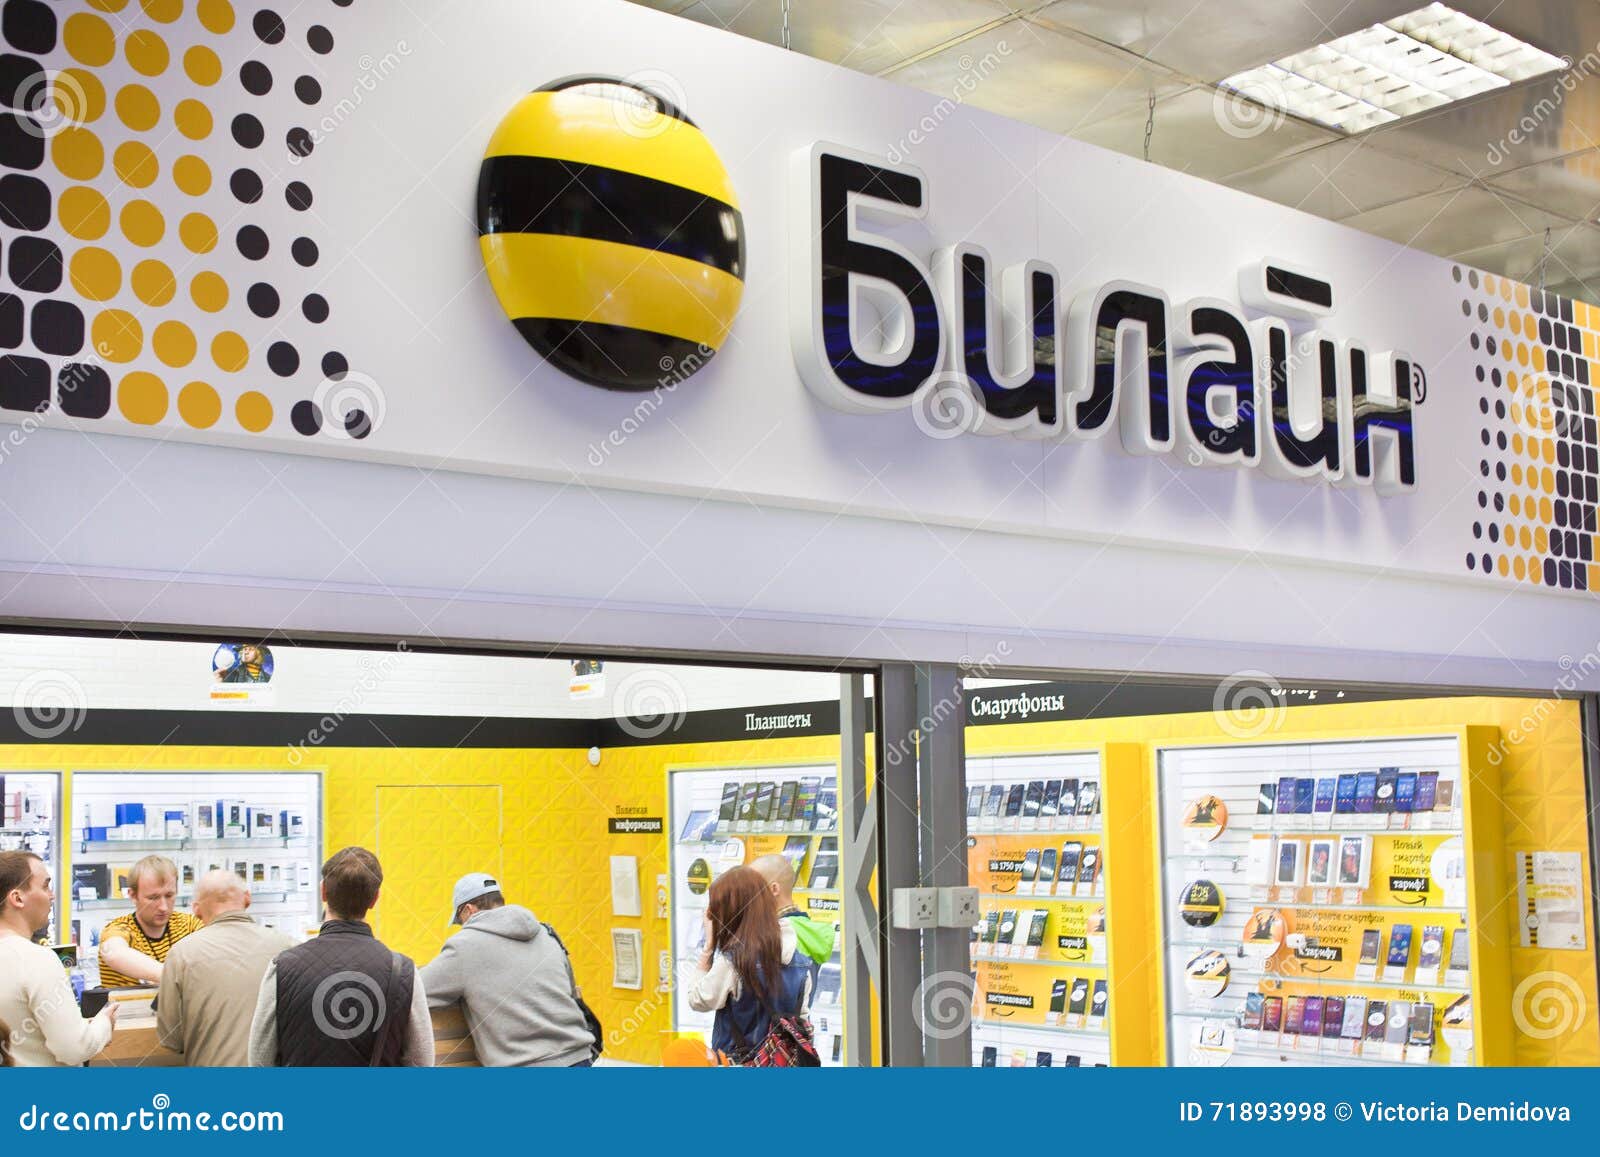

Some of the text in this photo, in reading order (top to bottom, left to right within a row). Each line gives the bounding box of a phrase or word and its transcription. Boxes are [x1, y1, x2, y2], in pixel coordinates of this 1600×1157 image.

[816, 150, 1418, 489] Билайн
[971, 692, 1065, 719] Смартфоны
[745, 713, 812, 731] Планшеты
[615, 819, 661, 832] информация
[1393, 840, 1423, 850] Новый
[1392, 879, 1425, 891] тариф!
